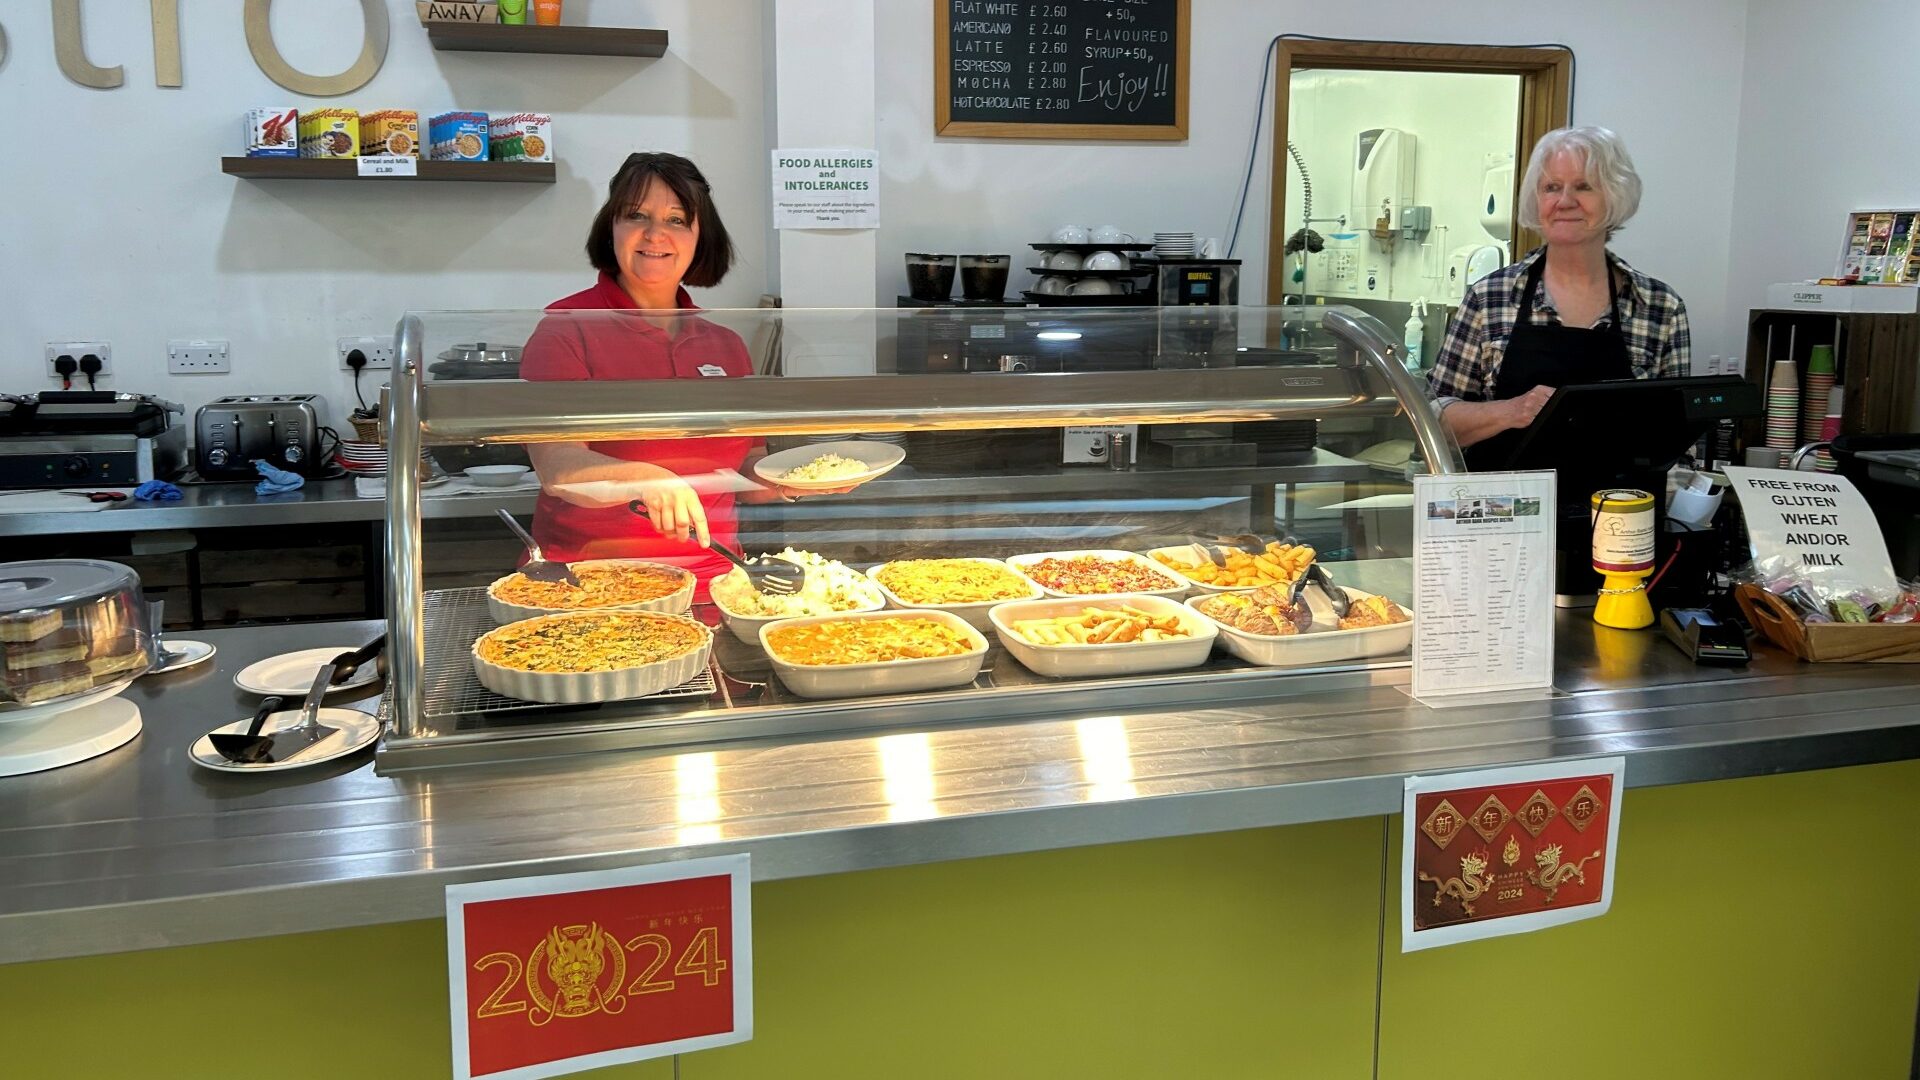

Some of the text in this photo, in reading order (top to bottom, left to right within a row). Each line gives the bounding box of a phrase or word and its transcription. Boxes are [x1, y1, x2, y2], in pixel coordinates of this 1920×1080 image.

[428, 3, 485, 22] AWAY
[954, 1, 1018, 15] FLAT WHITE
[1043, 5, 1067, 17] 2.60
[1042, 22, 1067, 35] 2.40
[1085, 28, 1168, 42] FLAVOURED
[955, 40, 1004, 54] LATTE
[1041, 41, 1067, 54] 2.60
[1040, 61, 1067, 73] 2.00
[1040, 77, 1067, 89] 2.80
[779, 158, 873, 169] FOOD ALLERGIES
[818, 170, 836, 178] and
[784, 181, 869, 191] INTOLERANCES
[1748, 479, 1840, 493] FREE FROM
[1771, 495, 1837, 507] GLUTEN
[1781, 513, 1838, 525] WHEAT
[1785, 533, 1850, 546] AND/OR
[1802, 554, 1844, 566] MILK
[1497, 888, 1523, 900] 2024
